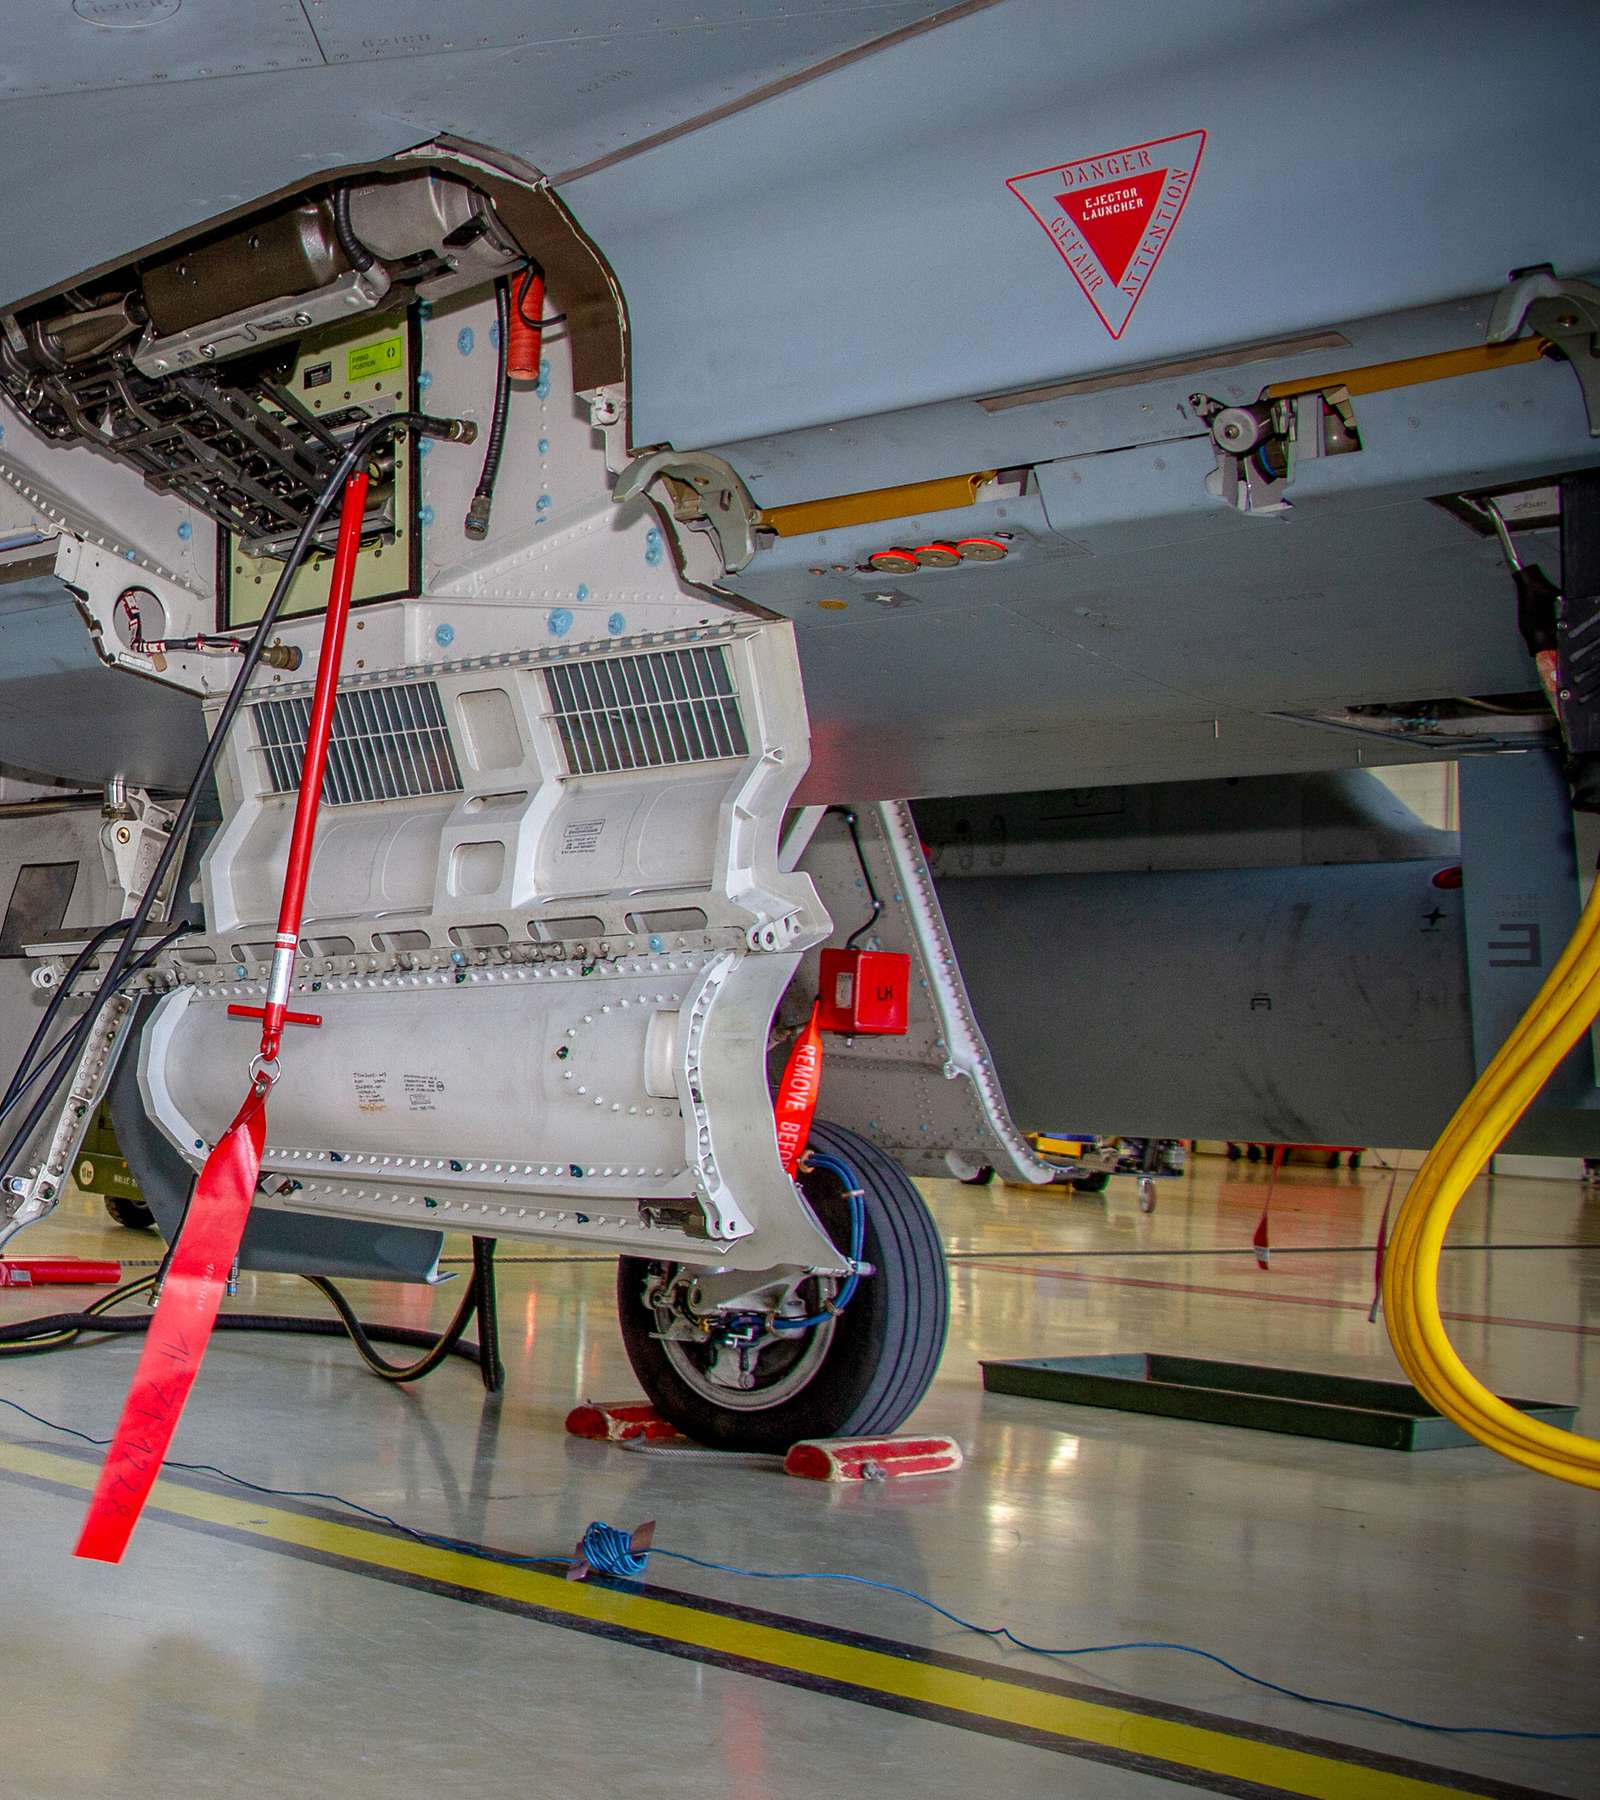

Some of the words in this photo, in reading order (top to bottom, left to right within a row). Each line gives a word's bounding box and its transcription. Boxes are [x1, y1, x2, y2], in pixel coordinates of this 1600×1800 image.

[1061, 150, 1151, 187] DANGER
[1082, 198, 1144, 222] LAUNCHER
[1085, 187, 1138, 208] EJECTOR
[1122, 168, 1189, 297] ATTENTION
[1050, 216, 1104, 292] GEFAHR
[876, 985, 893, 1001] LH
[785, 1044, 817, 1112] REMOVE
